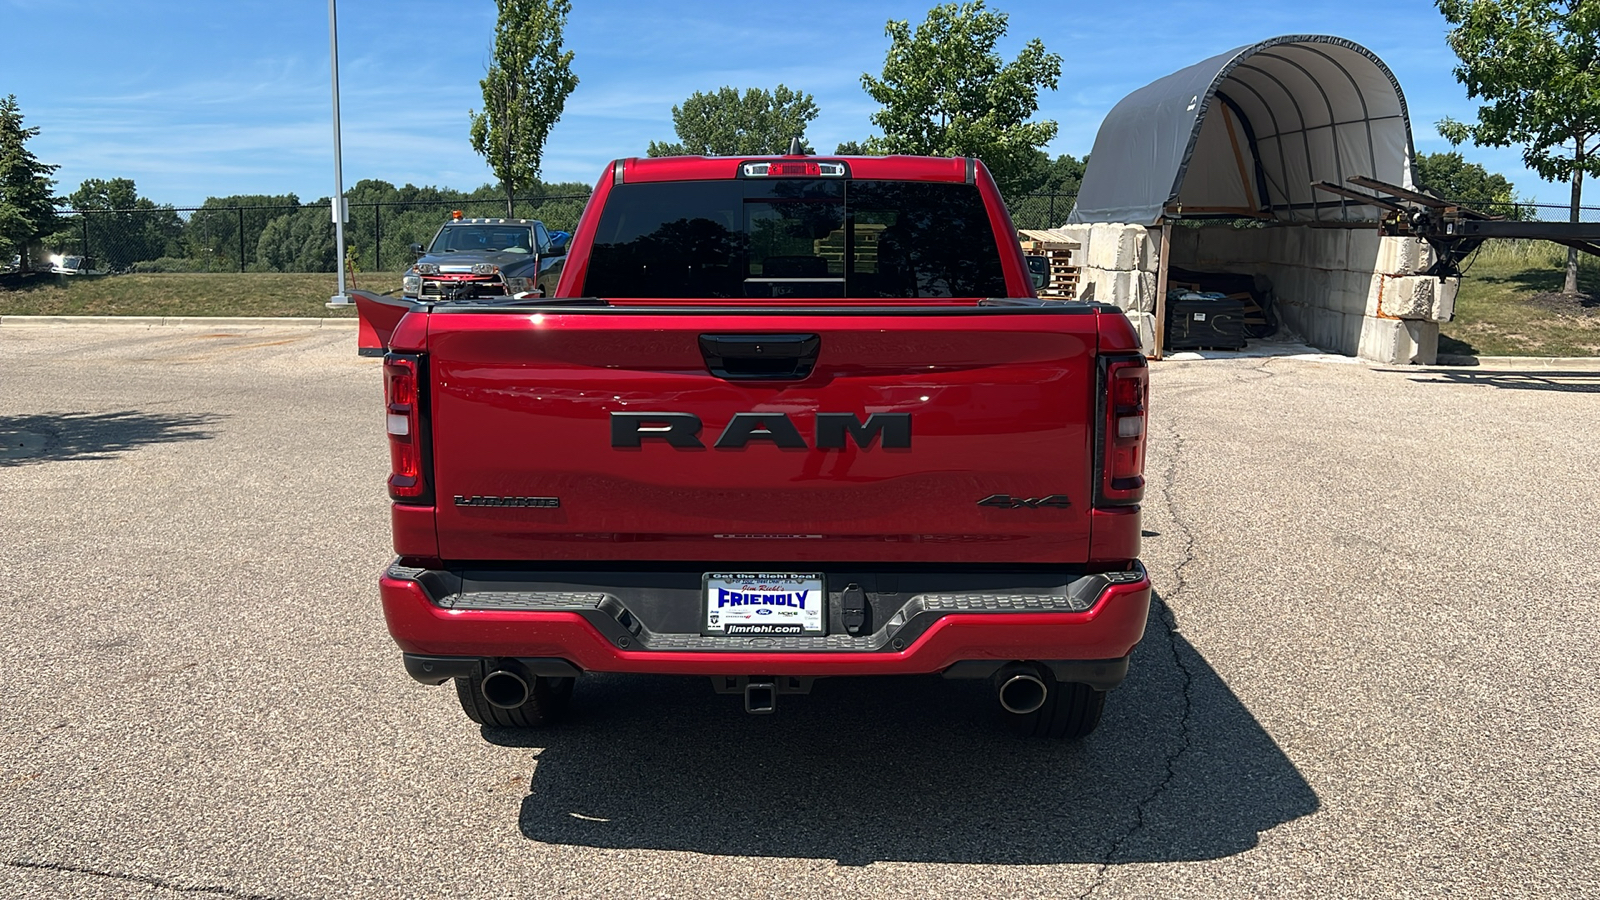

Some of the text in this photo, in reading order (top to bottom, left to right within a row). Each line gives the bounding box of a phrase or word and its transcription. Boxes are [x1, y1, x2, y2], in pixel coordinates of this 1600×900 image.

[610, 411, 913, 449] RAM
[741, 584, 758, 593] Jim
[718, 587, 809, 609] FRIENDLY
[727, 625, 801, 634] jimriehl.com
